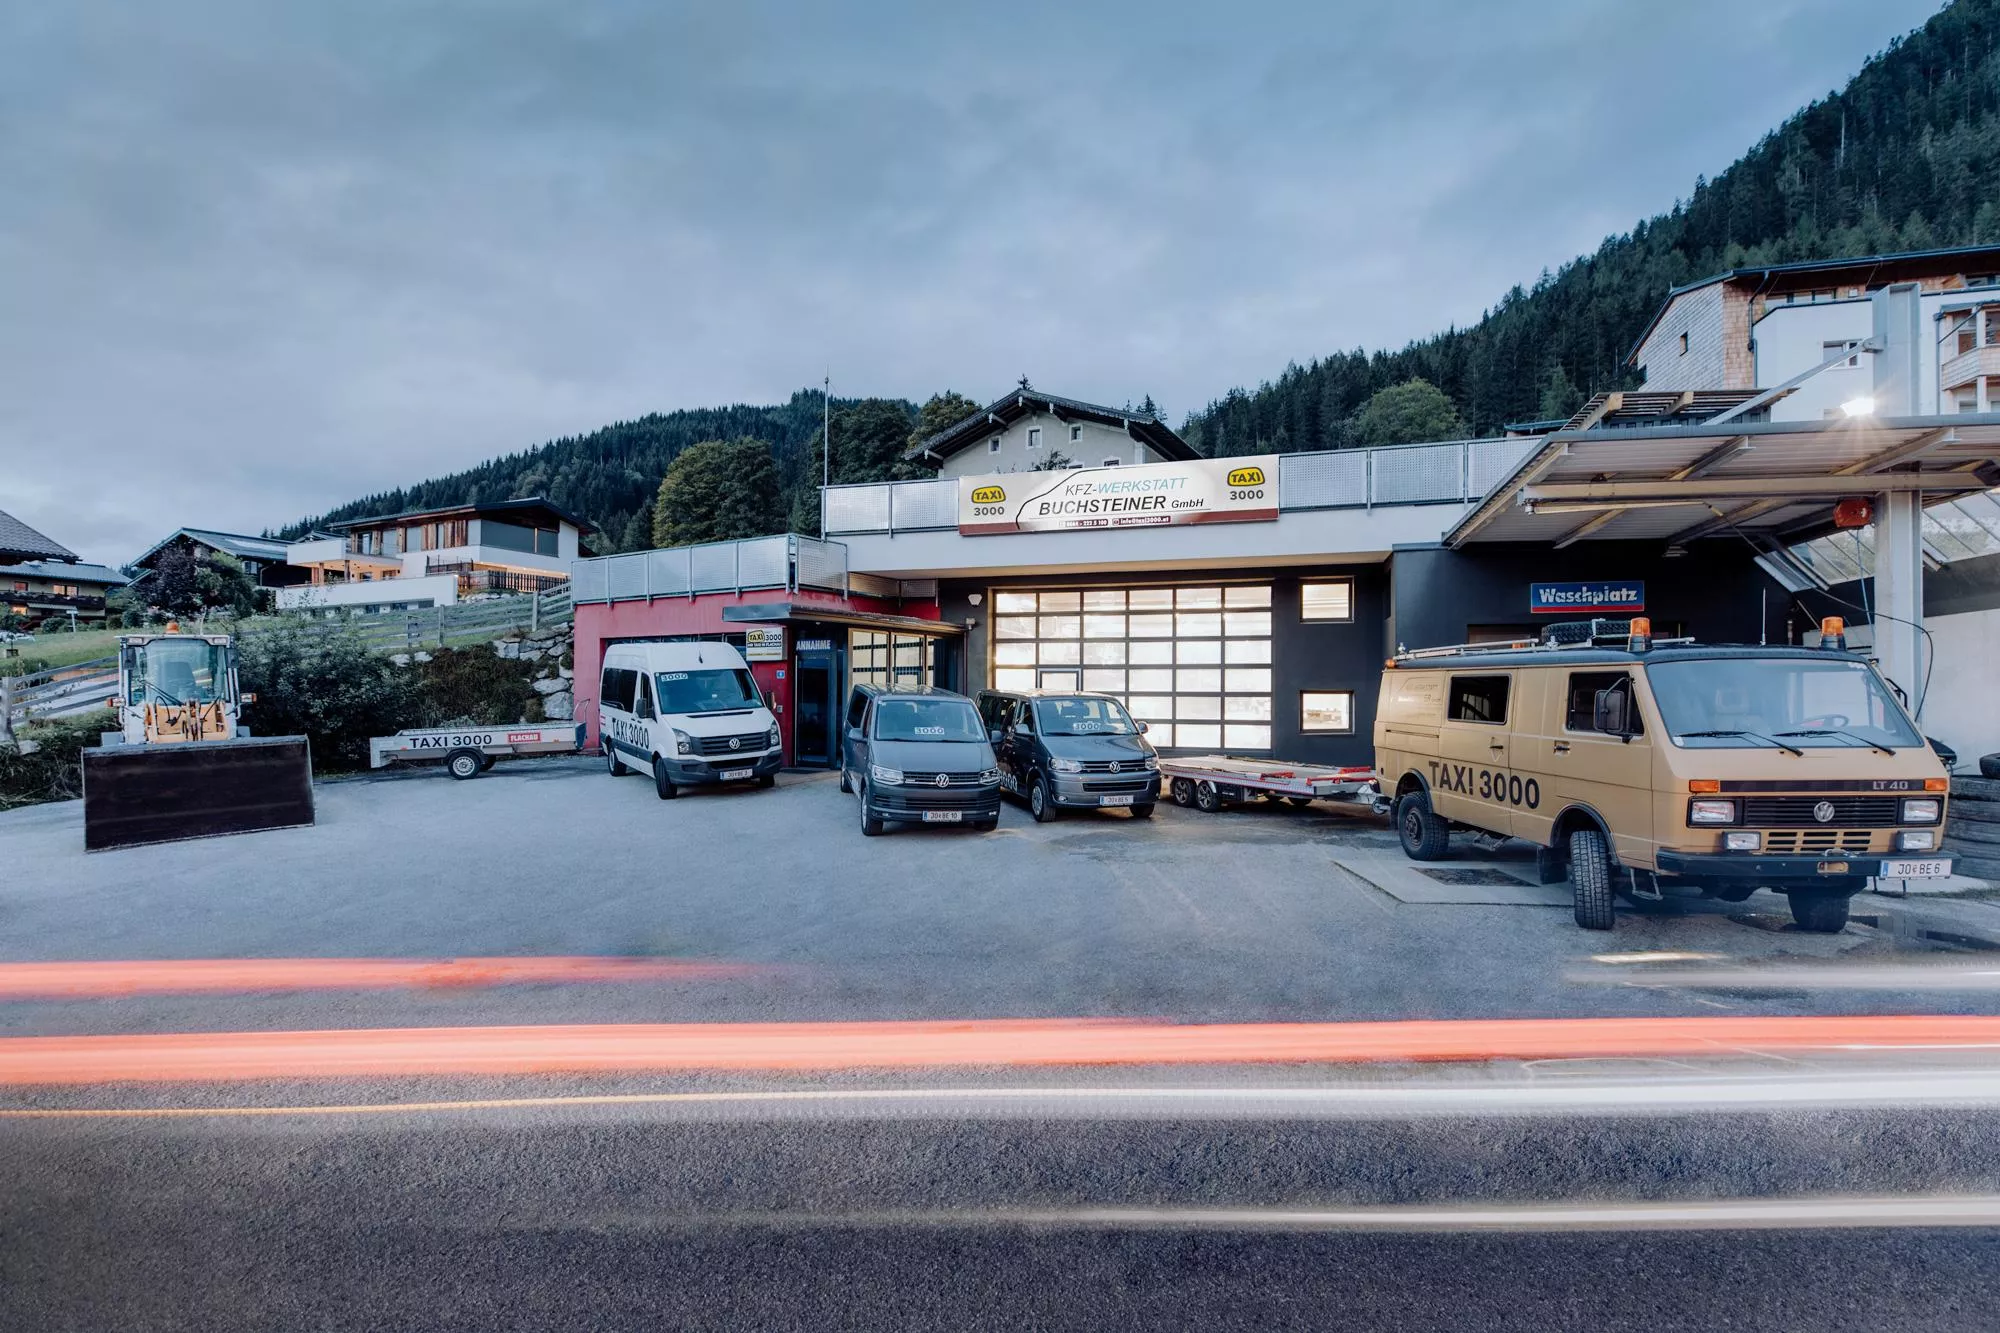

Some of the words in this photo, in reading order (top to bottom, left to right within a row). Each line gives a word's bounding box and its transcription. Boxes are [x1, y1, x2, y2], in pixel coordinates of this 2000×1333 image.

[1231, 472, 1261, 483] TAXI
[1065, 477, 1188, 496] KFZ-WERKSTATT
[975, 490, 1002, 500] TAXI
[1230, 489, 1264, 500] 3000
[1039, 495, 1167, 515] BUCHSTEINER
[1171, 498, 1204, 509] GmbH
[974, 506, 1005, 516] 3000
[749, 633, 764, 641] TAXI
[796, 640, 831, 650] ANNAHME
[662, 673, 688, 681] 3000
[409, 736, 448, 748] TAXI
[453, 735, 492, 746] 3000
[629, 723, 650, 750] 3000
[1480, 770, 1540, 809] 3000
[1873, 781, 1887, 790] LT
[1889, 781, 1908, 790] 40
[1898, 864, 1911, 874] JO
[1919, 863, 1932, 874] BE
[1934, 863, 1940, 874] 6
